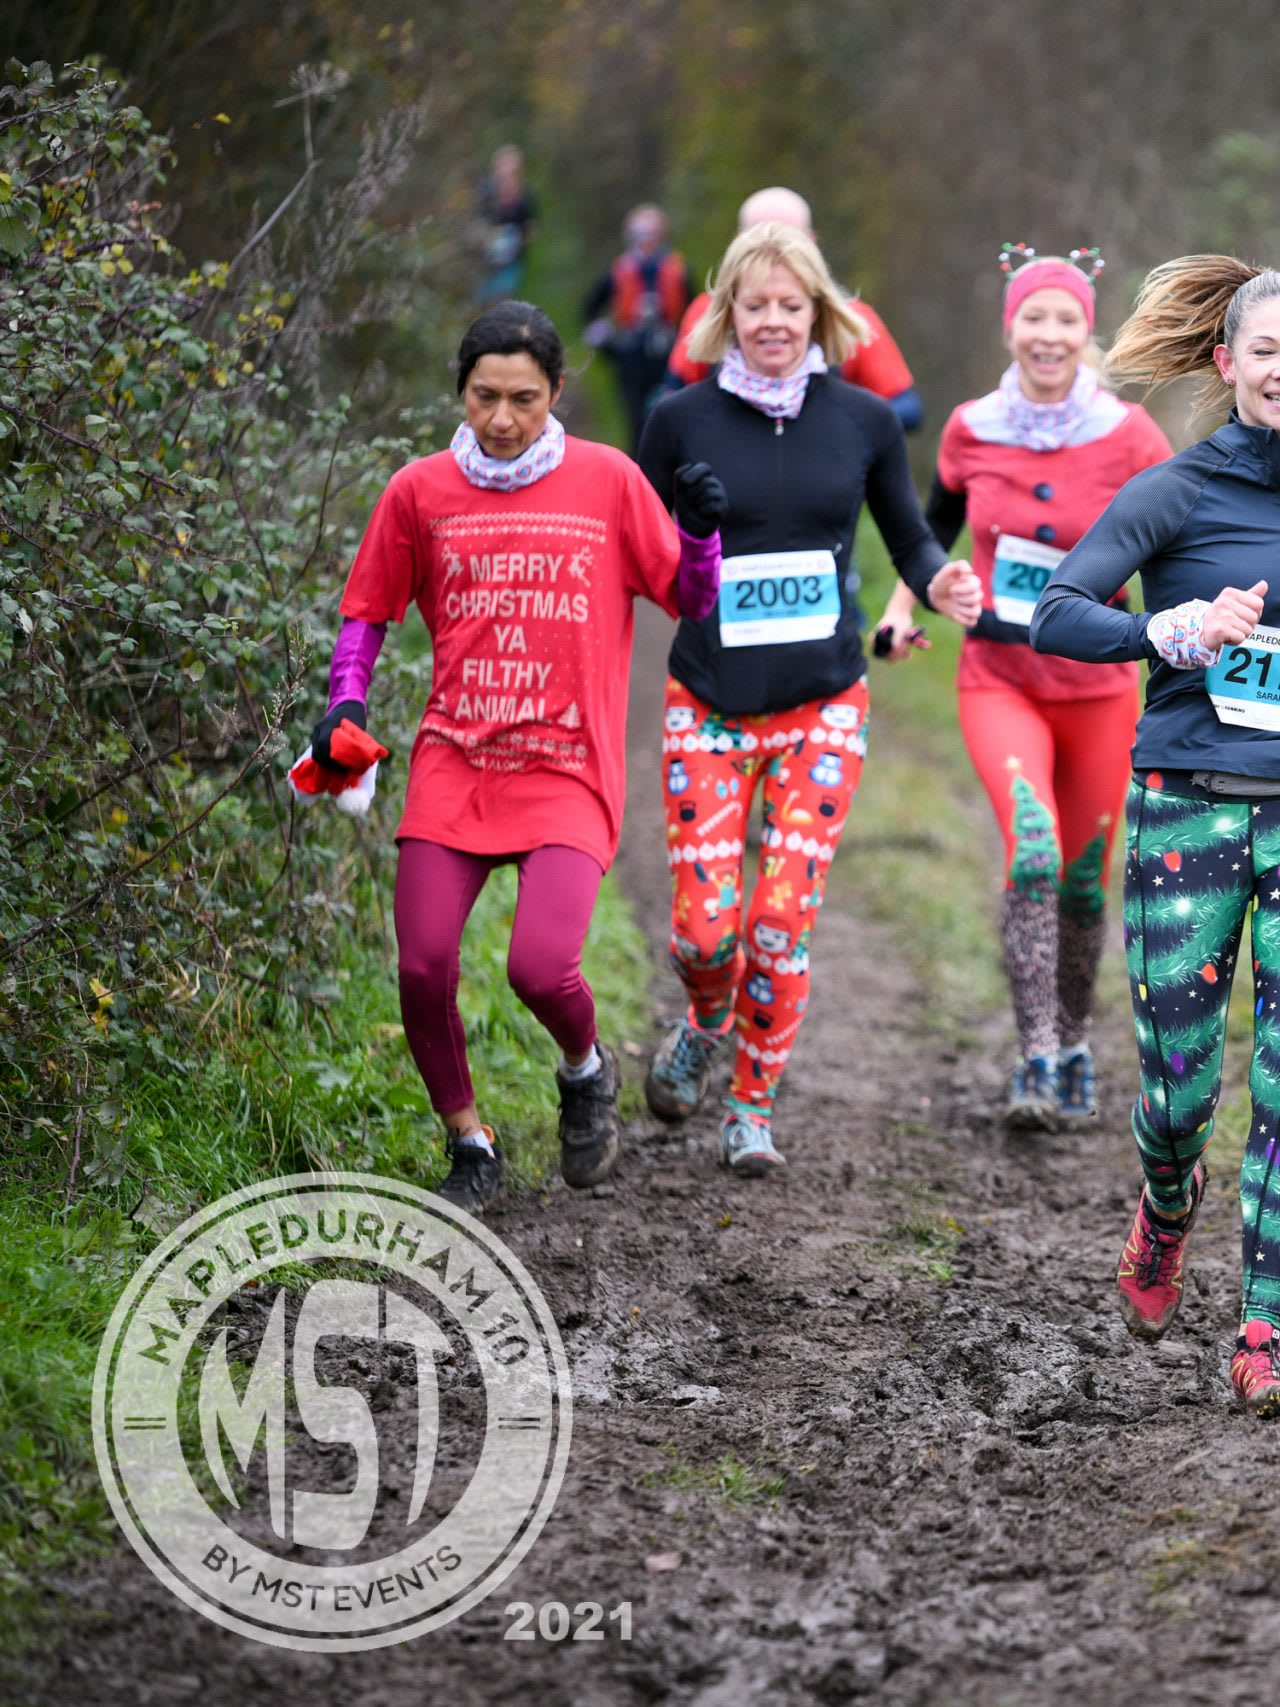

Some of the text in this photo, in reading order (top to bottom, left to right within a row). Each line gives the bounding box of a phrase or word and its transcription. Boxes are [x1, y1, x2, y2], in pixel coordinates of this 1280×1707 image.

[469, 552, 564, 583] MERRY
[446, 589, 589, 623] CHRISTMAS
[735, 575, 823, 611] 2003
[493, 624, 527, 654] YA
[462, 658, 552, 689] FILTHY
